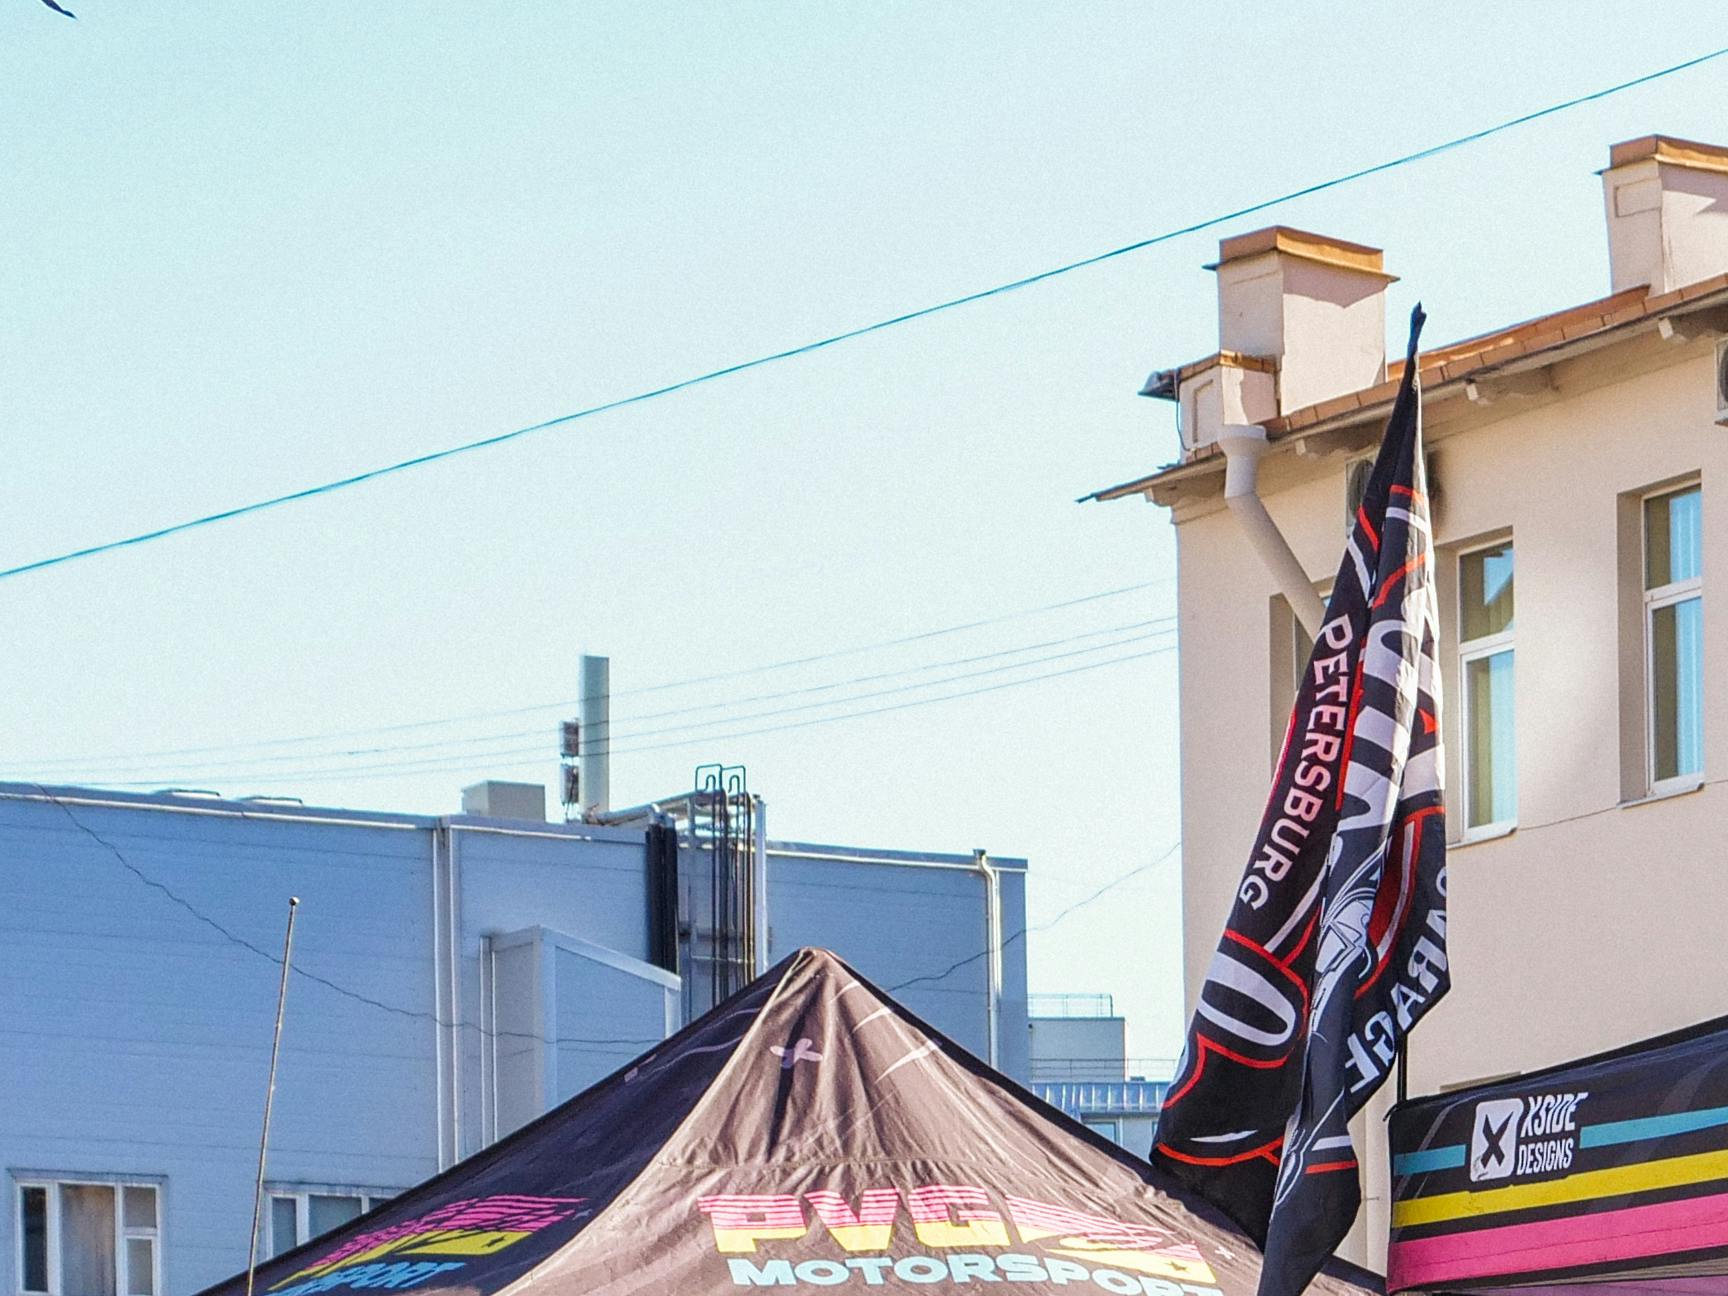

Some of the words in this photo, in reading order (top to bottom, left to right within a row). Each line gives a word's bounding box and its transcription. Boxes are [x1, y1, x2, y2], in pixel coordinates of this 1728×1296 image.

[1239, 613, 1354, 912] PETERSBURG
[1520, 1092, 1589, 1138] XSIDE
[1516, 1138, 1574, 1176] DESIGNS
